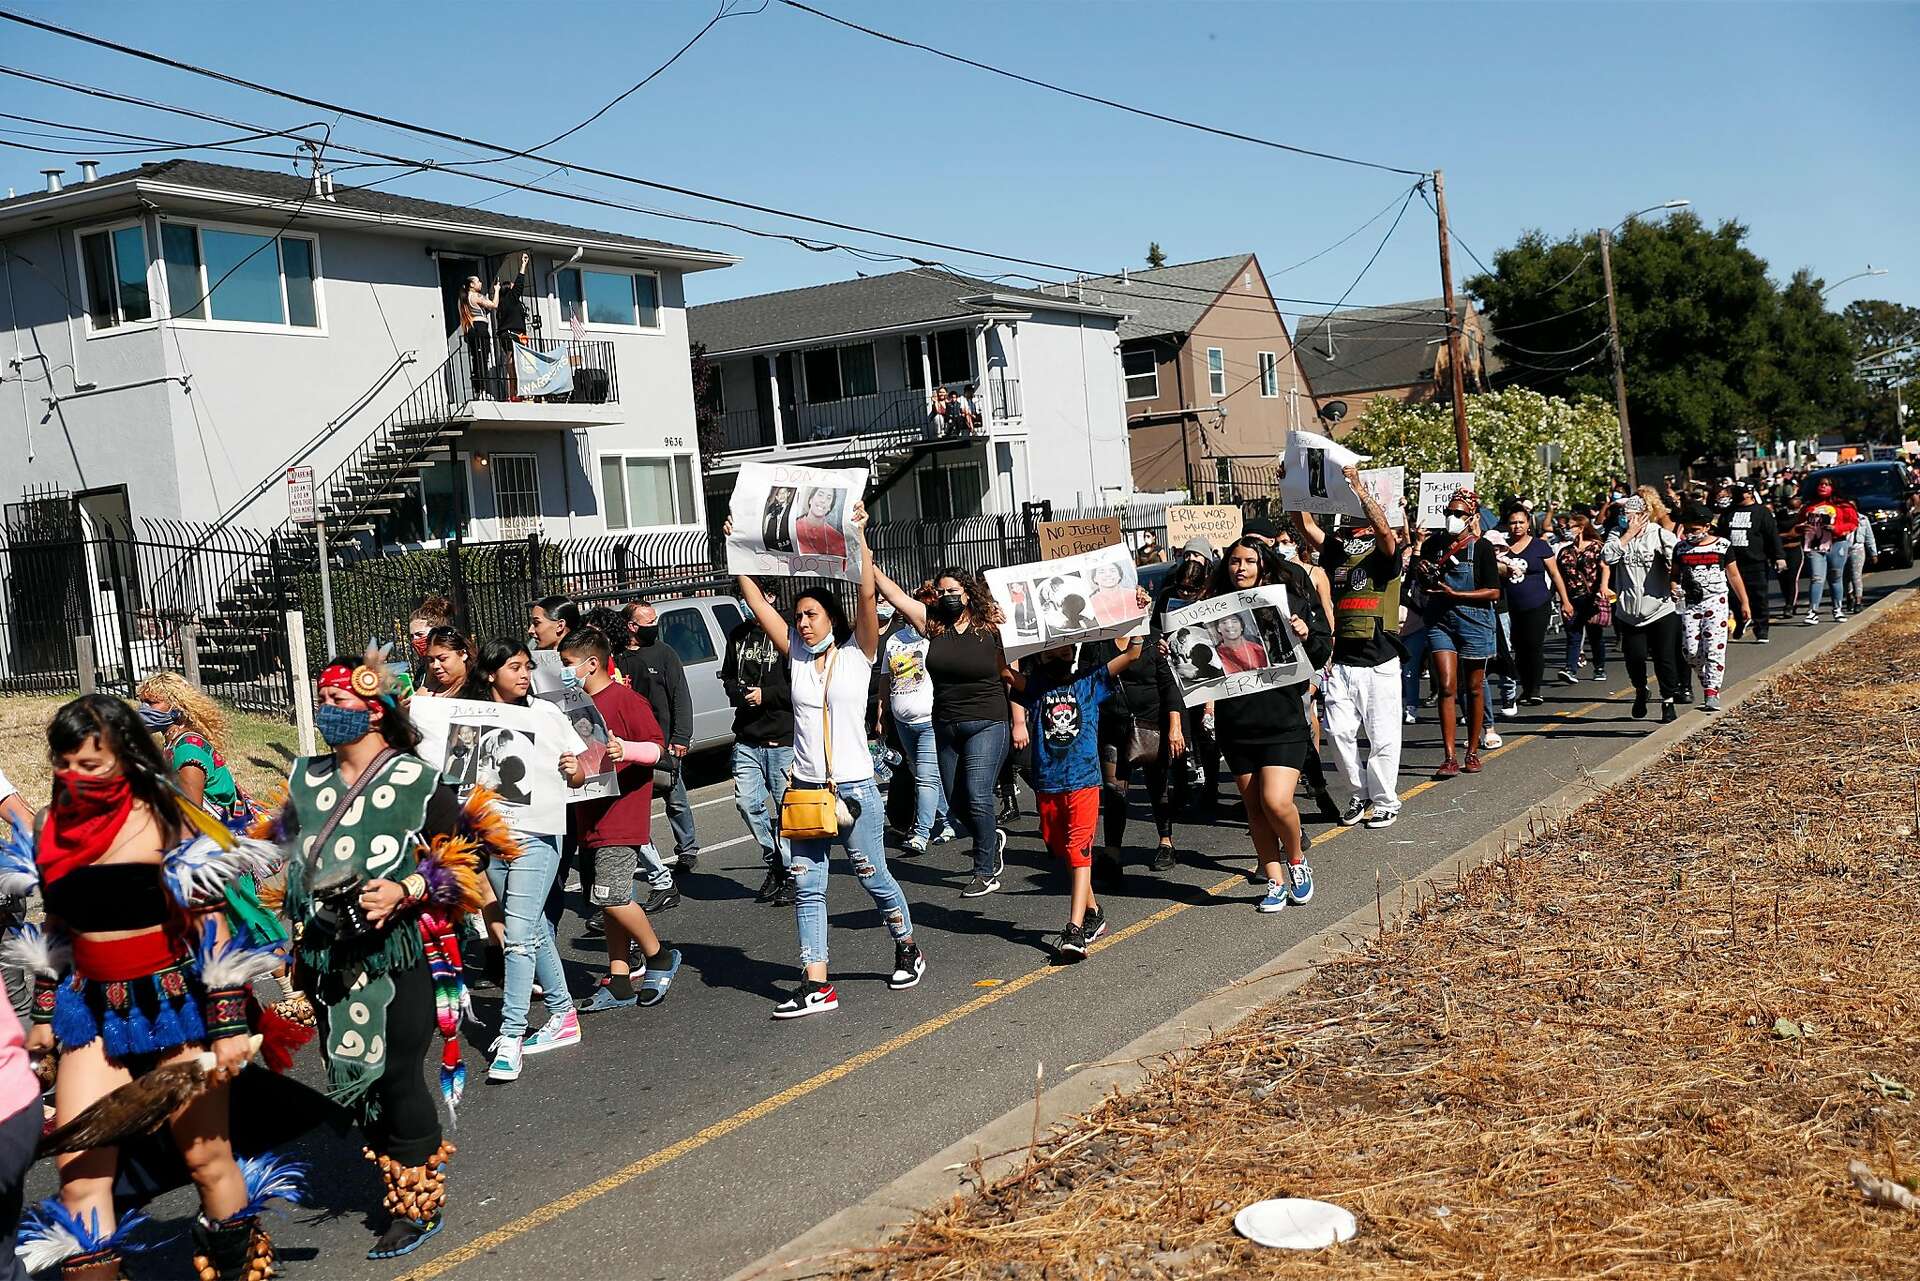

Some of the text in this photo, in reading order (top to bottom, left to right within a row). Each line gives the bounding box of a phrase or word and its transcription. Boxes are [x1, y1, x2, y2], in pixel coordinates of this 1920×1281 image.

[664, 436, 683, 447] 9636
[1046, 526, 1065, 541] NO
[1051, 544, 1070, 559] NO
[1172, 591, 1260, 626] Justice For
